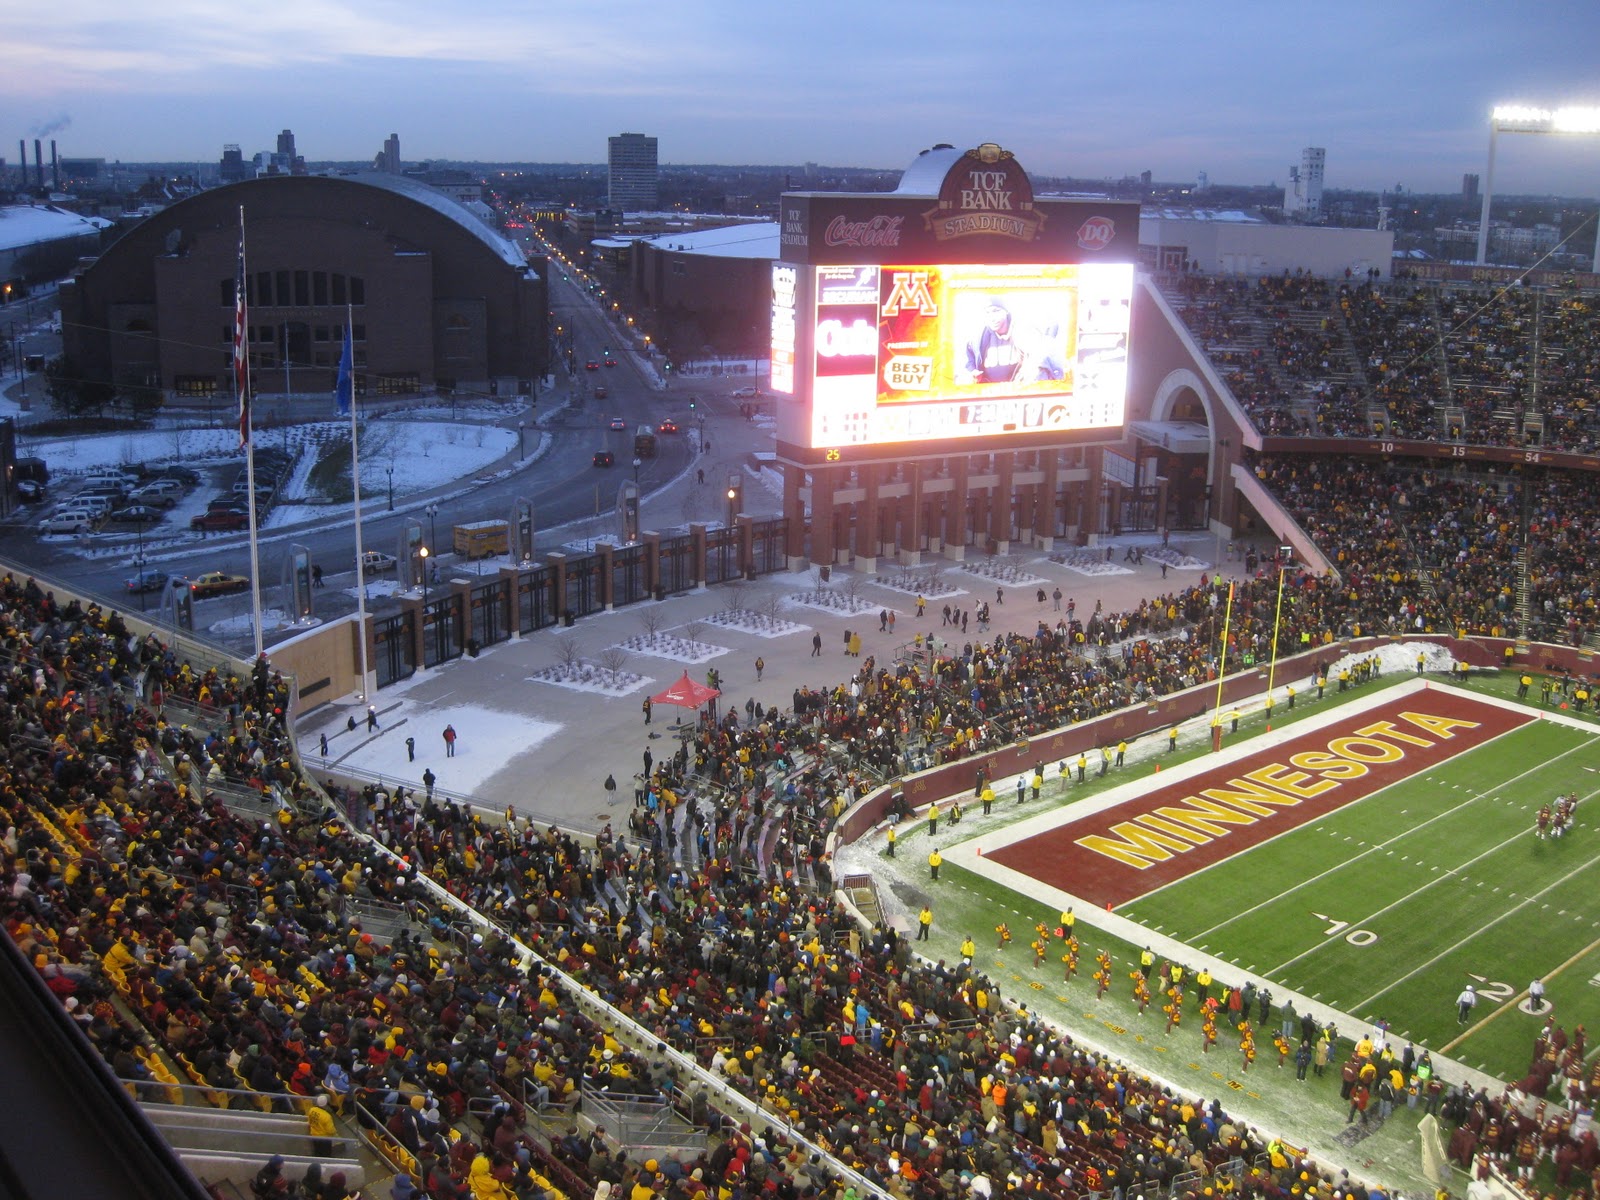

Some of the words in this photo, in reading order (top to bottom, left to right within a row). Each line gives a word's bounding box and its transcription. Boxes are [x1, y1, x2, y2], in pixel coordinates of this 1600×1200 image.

[970, 171, 1007, 191] TCF
[960, 190, 1012, 210] BANK
[789, 209, 801, 220] TCF
[786, 222, 803, 233] BANK
[825, 215, 905, 246] Coca-Cola
[944, 215, 1025, 236] STADIUM
[781, 234, 808, 246] STADIUM
[881, 272, 938, 316] M
[891, 362, 930, 373] BEST
[892, 373, 925, 384] BUY
[1381, 442, 1394, 452] 10
[1452, 446, 1465, 456] 15
[826, 449, 840, 460] 25
[1525, 453, 1540, 463] 54
[1073, 711, 1482, 870] MINNESOTA
[1323, 918, 1378, 946] 10
